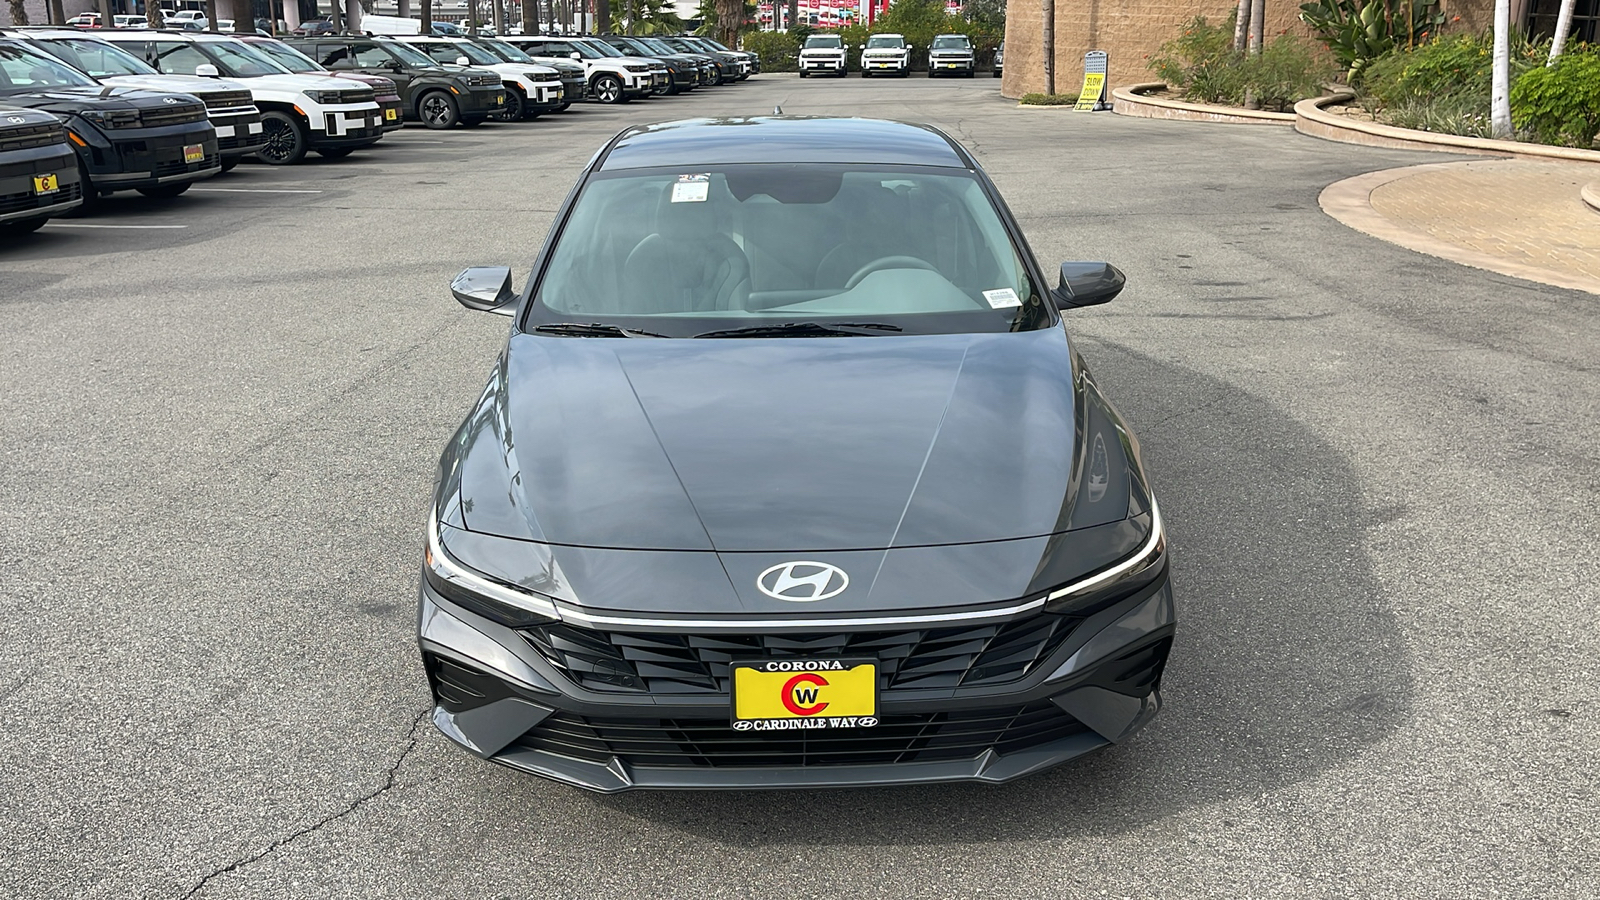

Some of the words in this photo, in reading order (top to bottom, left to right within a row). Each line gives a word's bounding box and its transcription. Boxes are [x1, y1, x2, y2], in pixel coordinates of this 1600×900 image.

[1086, 77, 1102, 86] SLOW
[766, 660, 843, 671] CORONA
[754, 718, 826, 730] CARDINALE
[828, 717, 858, 728] WAY
